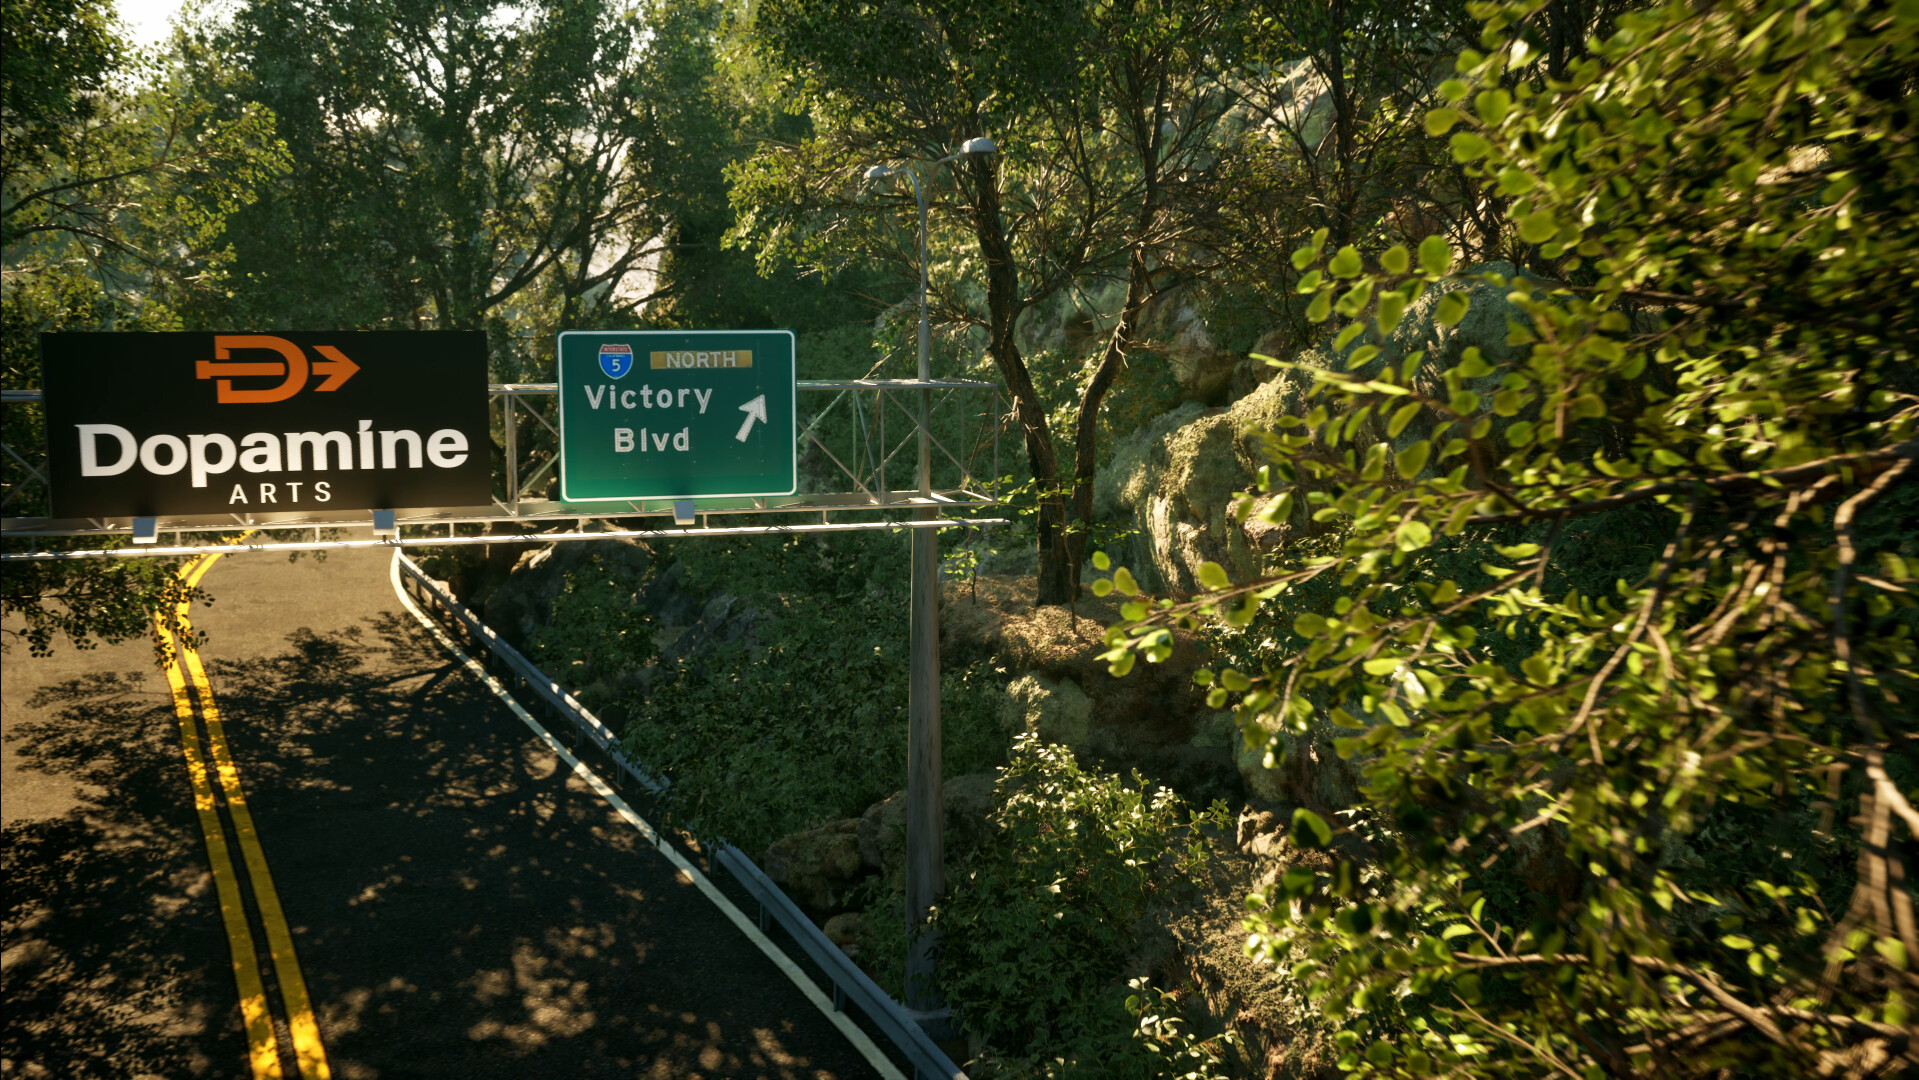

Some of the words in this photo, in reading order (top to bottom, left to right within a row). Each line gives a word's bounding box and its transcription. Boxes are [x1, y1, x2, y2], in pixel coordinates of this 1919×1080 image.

[612, 359, 621, 372] 5
[666, 352, 736, 369] NORTH
[584, 384, 713, 414] Victory
[614, 427, 690, 453] Blvd
[74, 420, 469, 488] Dopamine
[229, 482, 333, 505] ARTS
